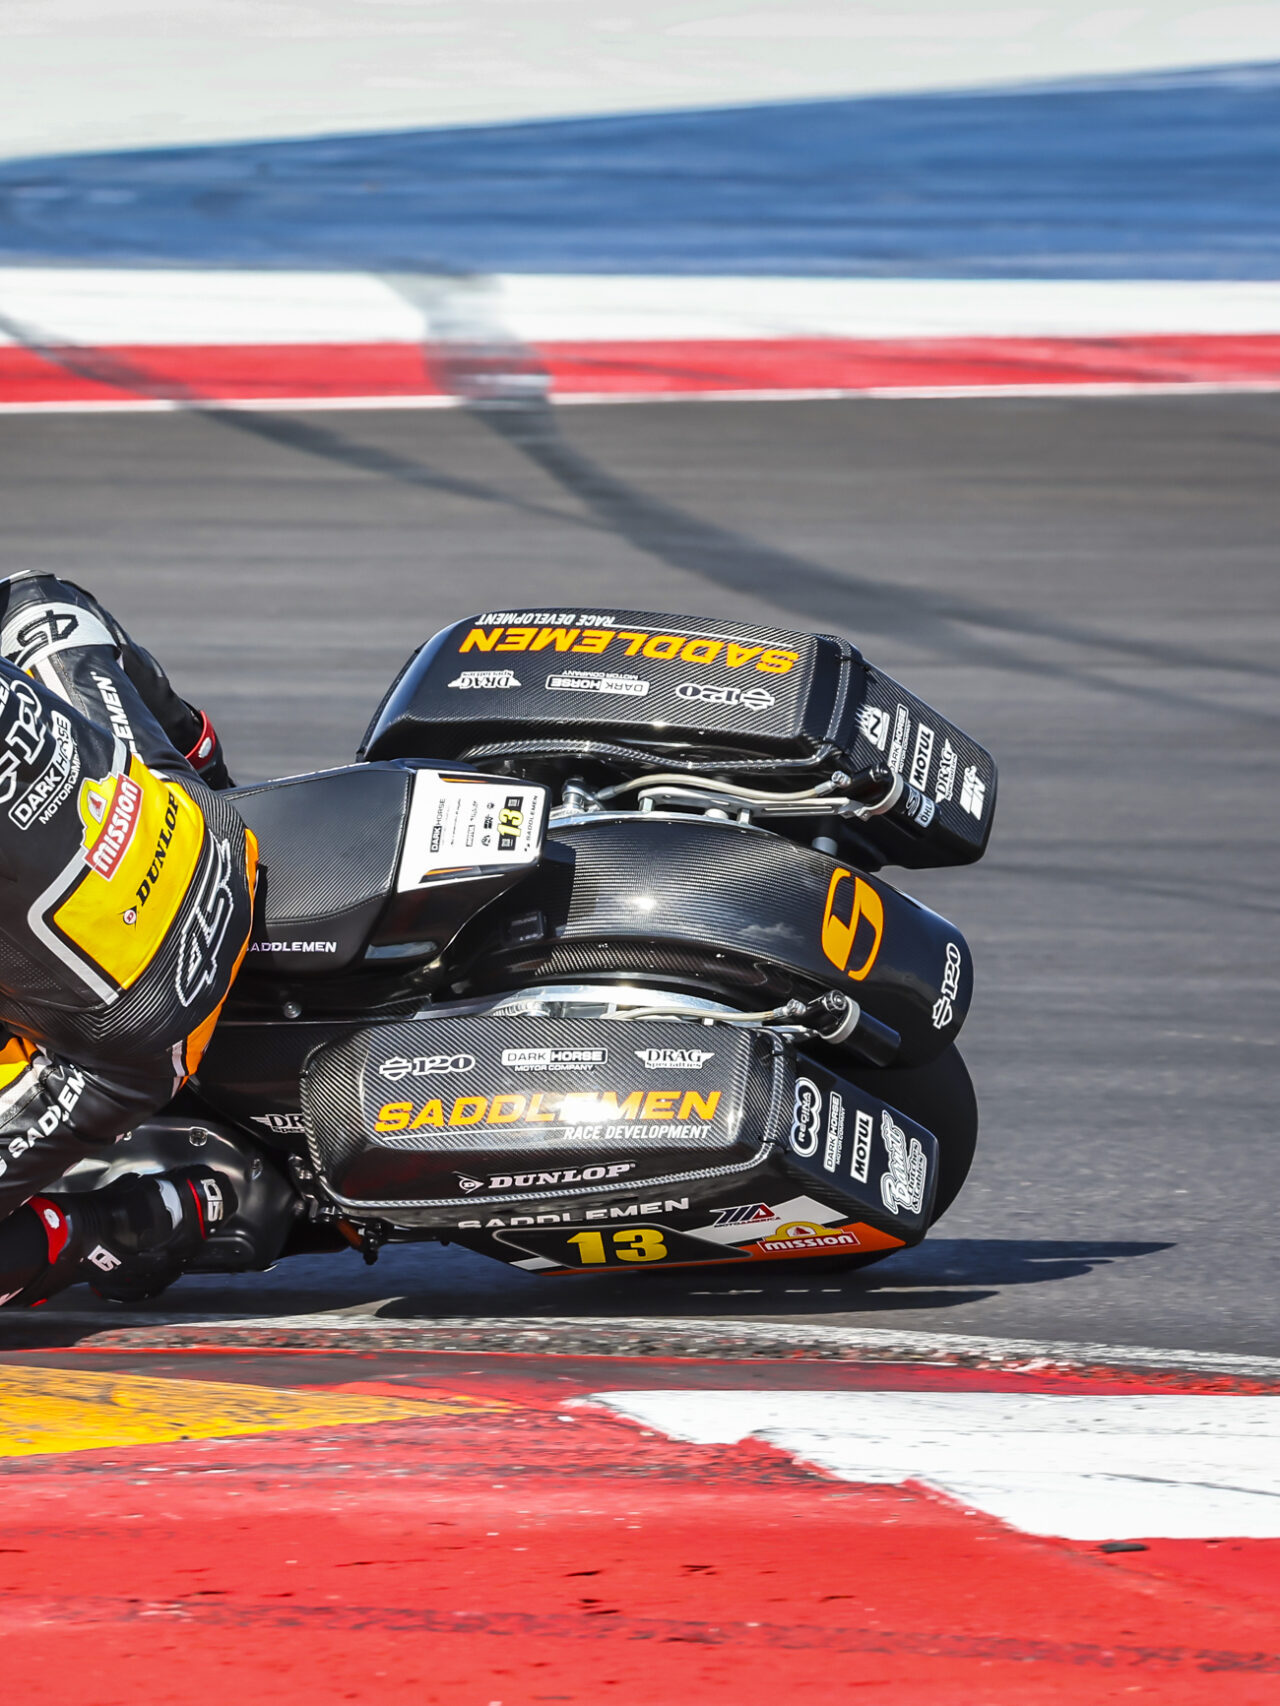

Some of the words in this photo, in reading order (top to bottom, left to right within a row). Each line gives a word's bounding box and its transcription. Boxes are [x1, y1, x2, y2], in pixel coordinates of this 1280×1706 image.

[475, 612, 572, 626] DEVELOPMENT
[576, 614, 615, 627] RACE
[459, 627, 799, 673] SADDLEMEN
[460, 676, 513, 690] DRAG
[550, 677, 603, 691] HORSE
[604, 682, 646, 693] DARK
[896, 709, 907, 744] HORSE
[913, 731, 931, 789] MOTUL
[937, 750, 953, 796] DRAG
[14, 767, 64, 823] DARK
[39, 784, 73, 824] MOTOR
[436, 798, 446, 826] HORSE
[497, 808, 524, 837] 13
[526, 795, 538, 841] SADDLEMEN
[136, 792, 180, 907] DUNLOP
[431, 826, 442, 852] DARK
[412, 1054, 476, 1077] 120
[508, 1052, 546, 1063] DARK
[551, 1050, 604, 1062] HORSE
[515, 1064, 547, 1072] MOTOR
[548, 1063, 594, 1072] COMPANY
[647, 1048, 702, 1063] DRAG
[269, 1115, 305, 1128] DR
[798, 1092, 812, 1142] REGINA
[830, 1096, 840, 1135] HORSE
[564, 1126, 601, 1140] RACE
[604, 1124, 712, 1139] DEVELOPMENT
[826, 1137, 837, 1168] DARK
[854, 1116, 870, 1178] MOTUL
[487, 1164, 631, 1189] DUNLOP
[566, 1229, 668, 1264] 13
